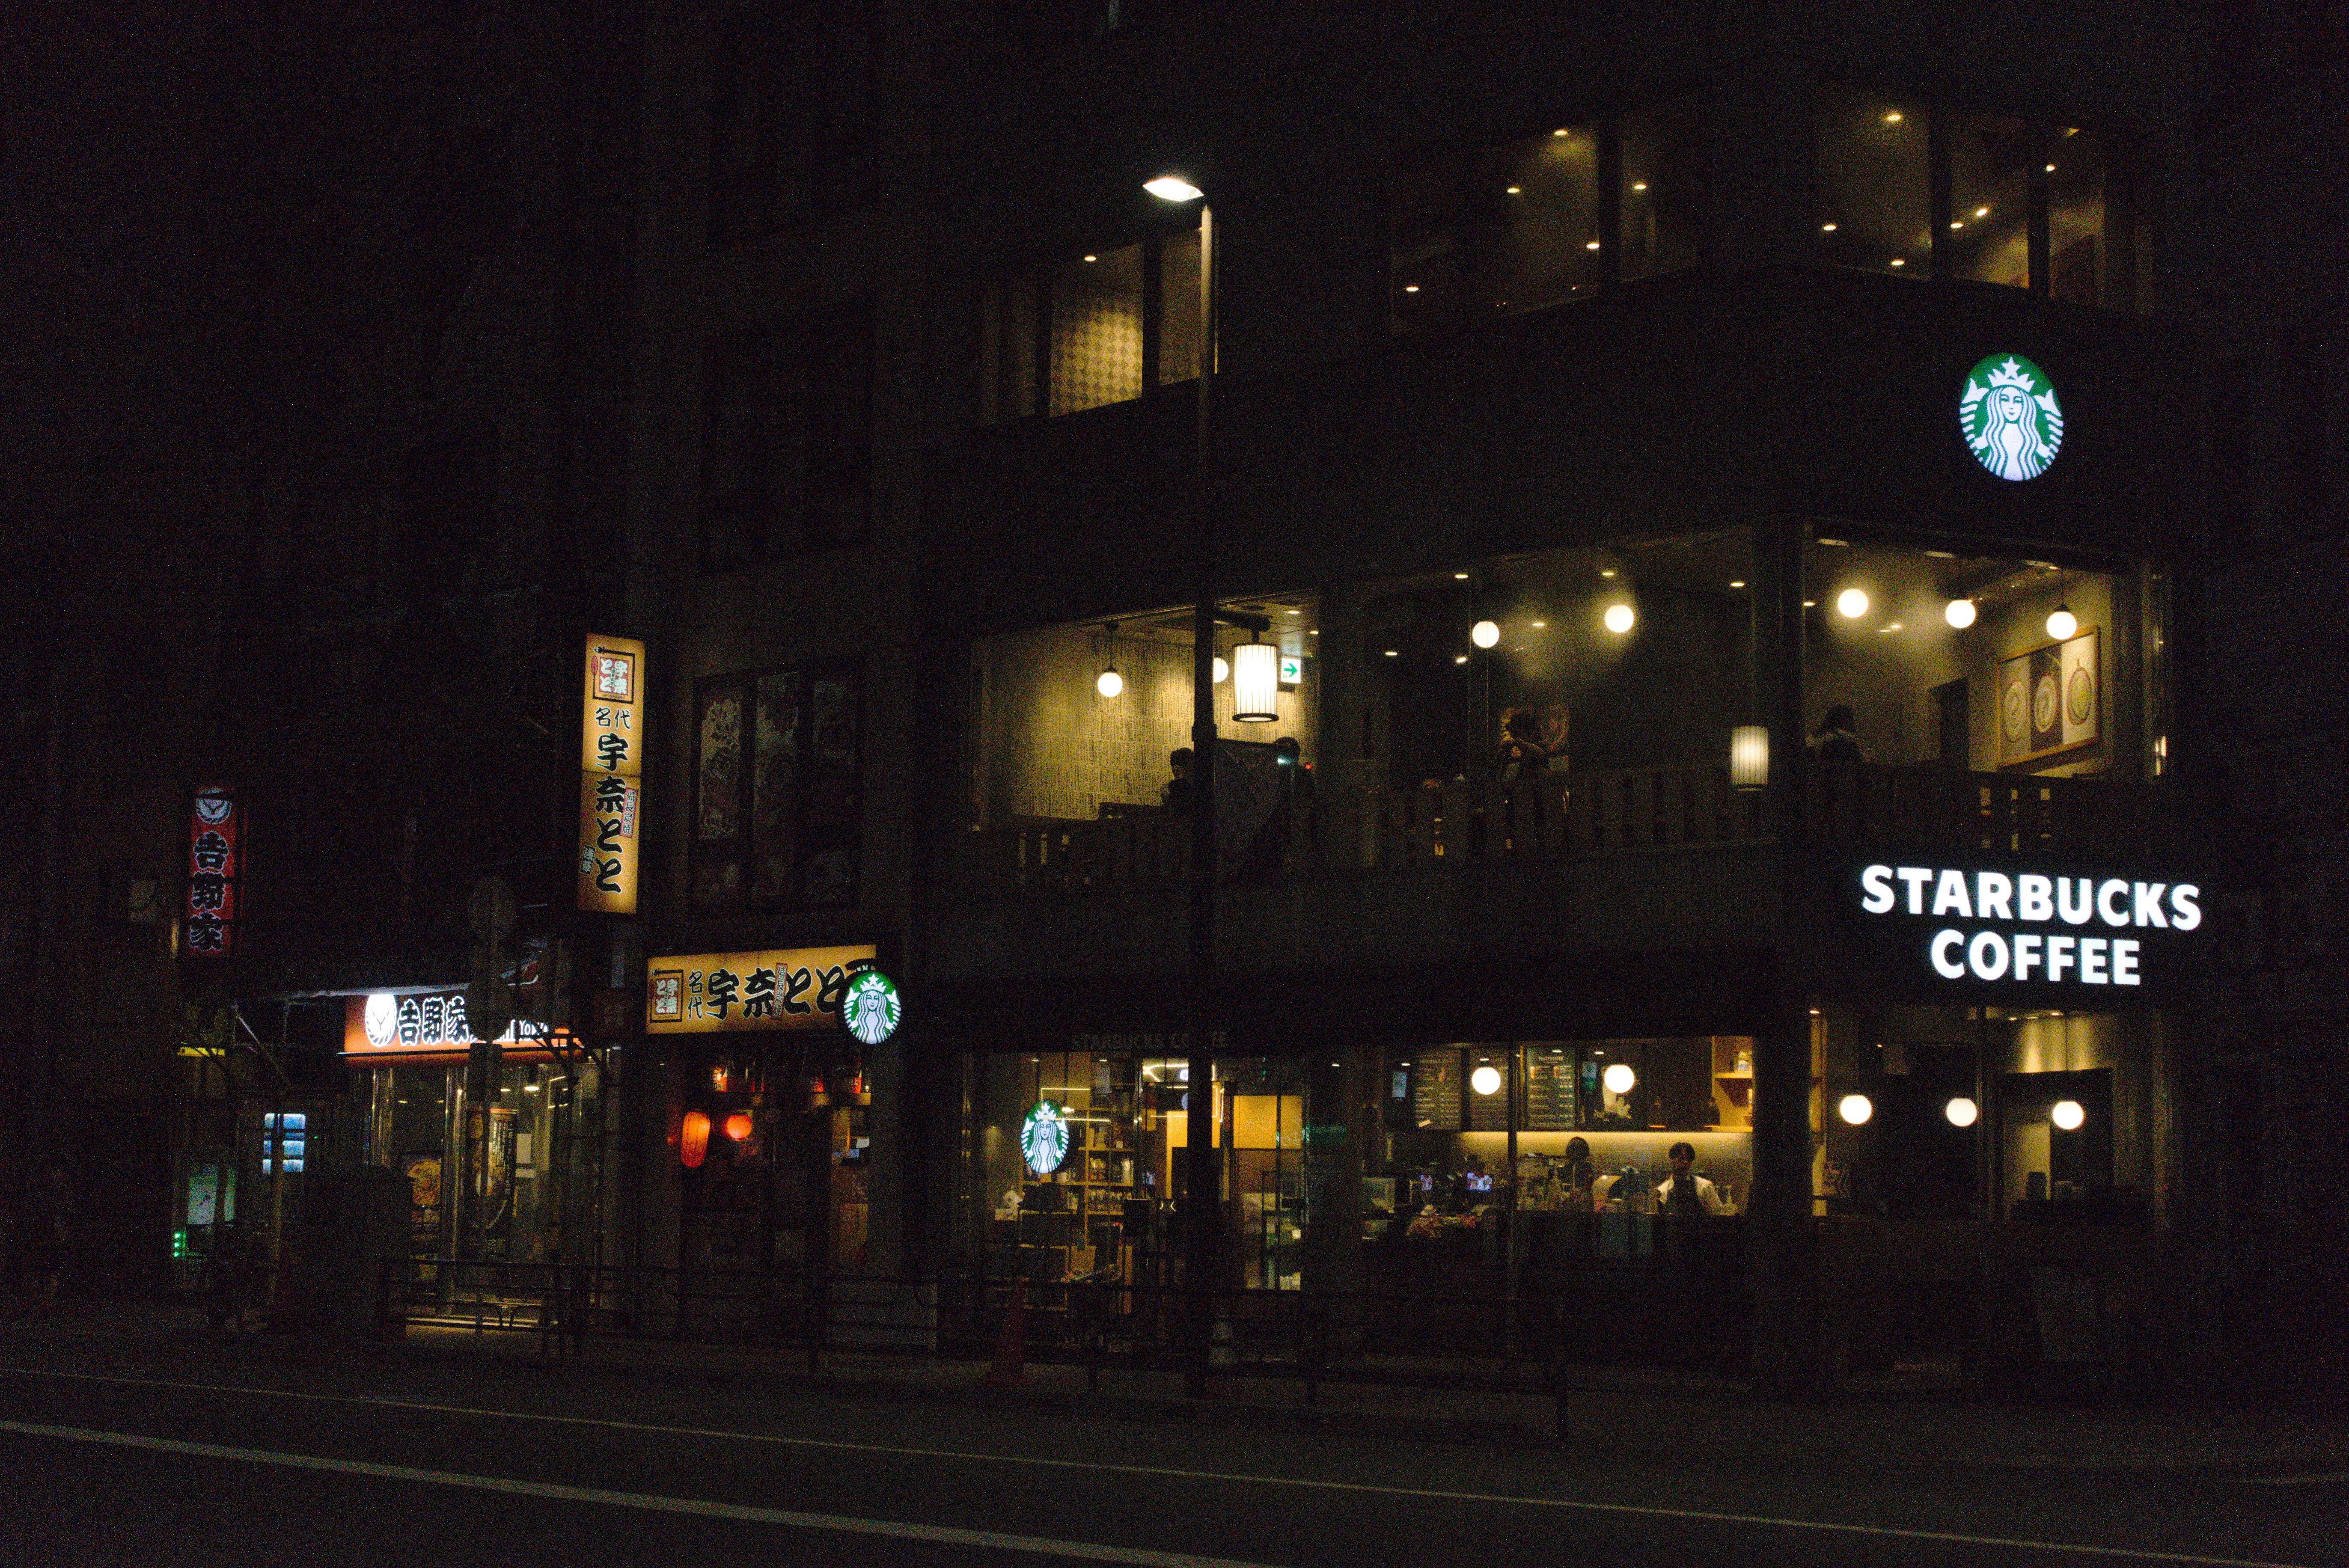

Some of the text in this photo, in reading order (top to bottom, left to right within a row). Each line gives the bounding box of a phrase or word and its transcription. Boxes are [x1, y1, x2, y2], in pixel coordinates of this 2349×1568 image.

[595, 706, 631, 730] 名代
[595, 732, 630, 894] 宇奈とと
[189, 830, 230, 952] 吉野家
[1860, 864, 2203, 931] STARBUCKS
[1930, 929, 2142, 986] COFFEE
[687, 970, 704, 1021] 名代
[706, 965, 845, 1020] 宇奈とと
[397, 996, 470, 1045] 吉野家
[1071, 1031, 1228, 1051] STARBUCKS COEE
